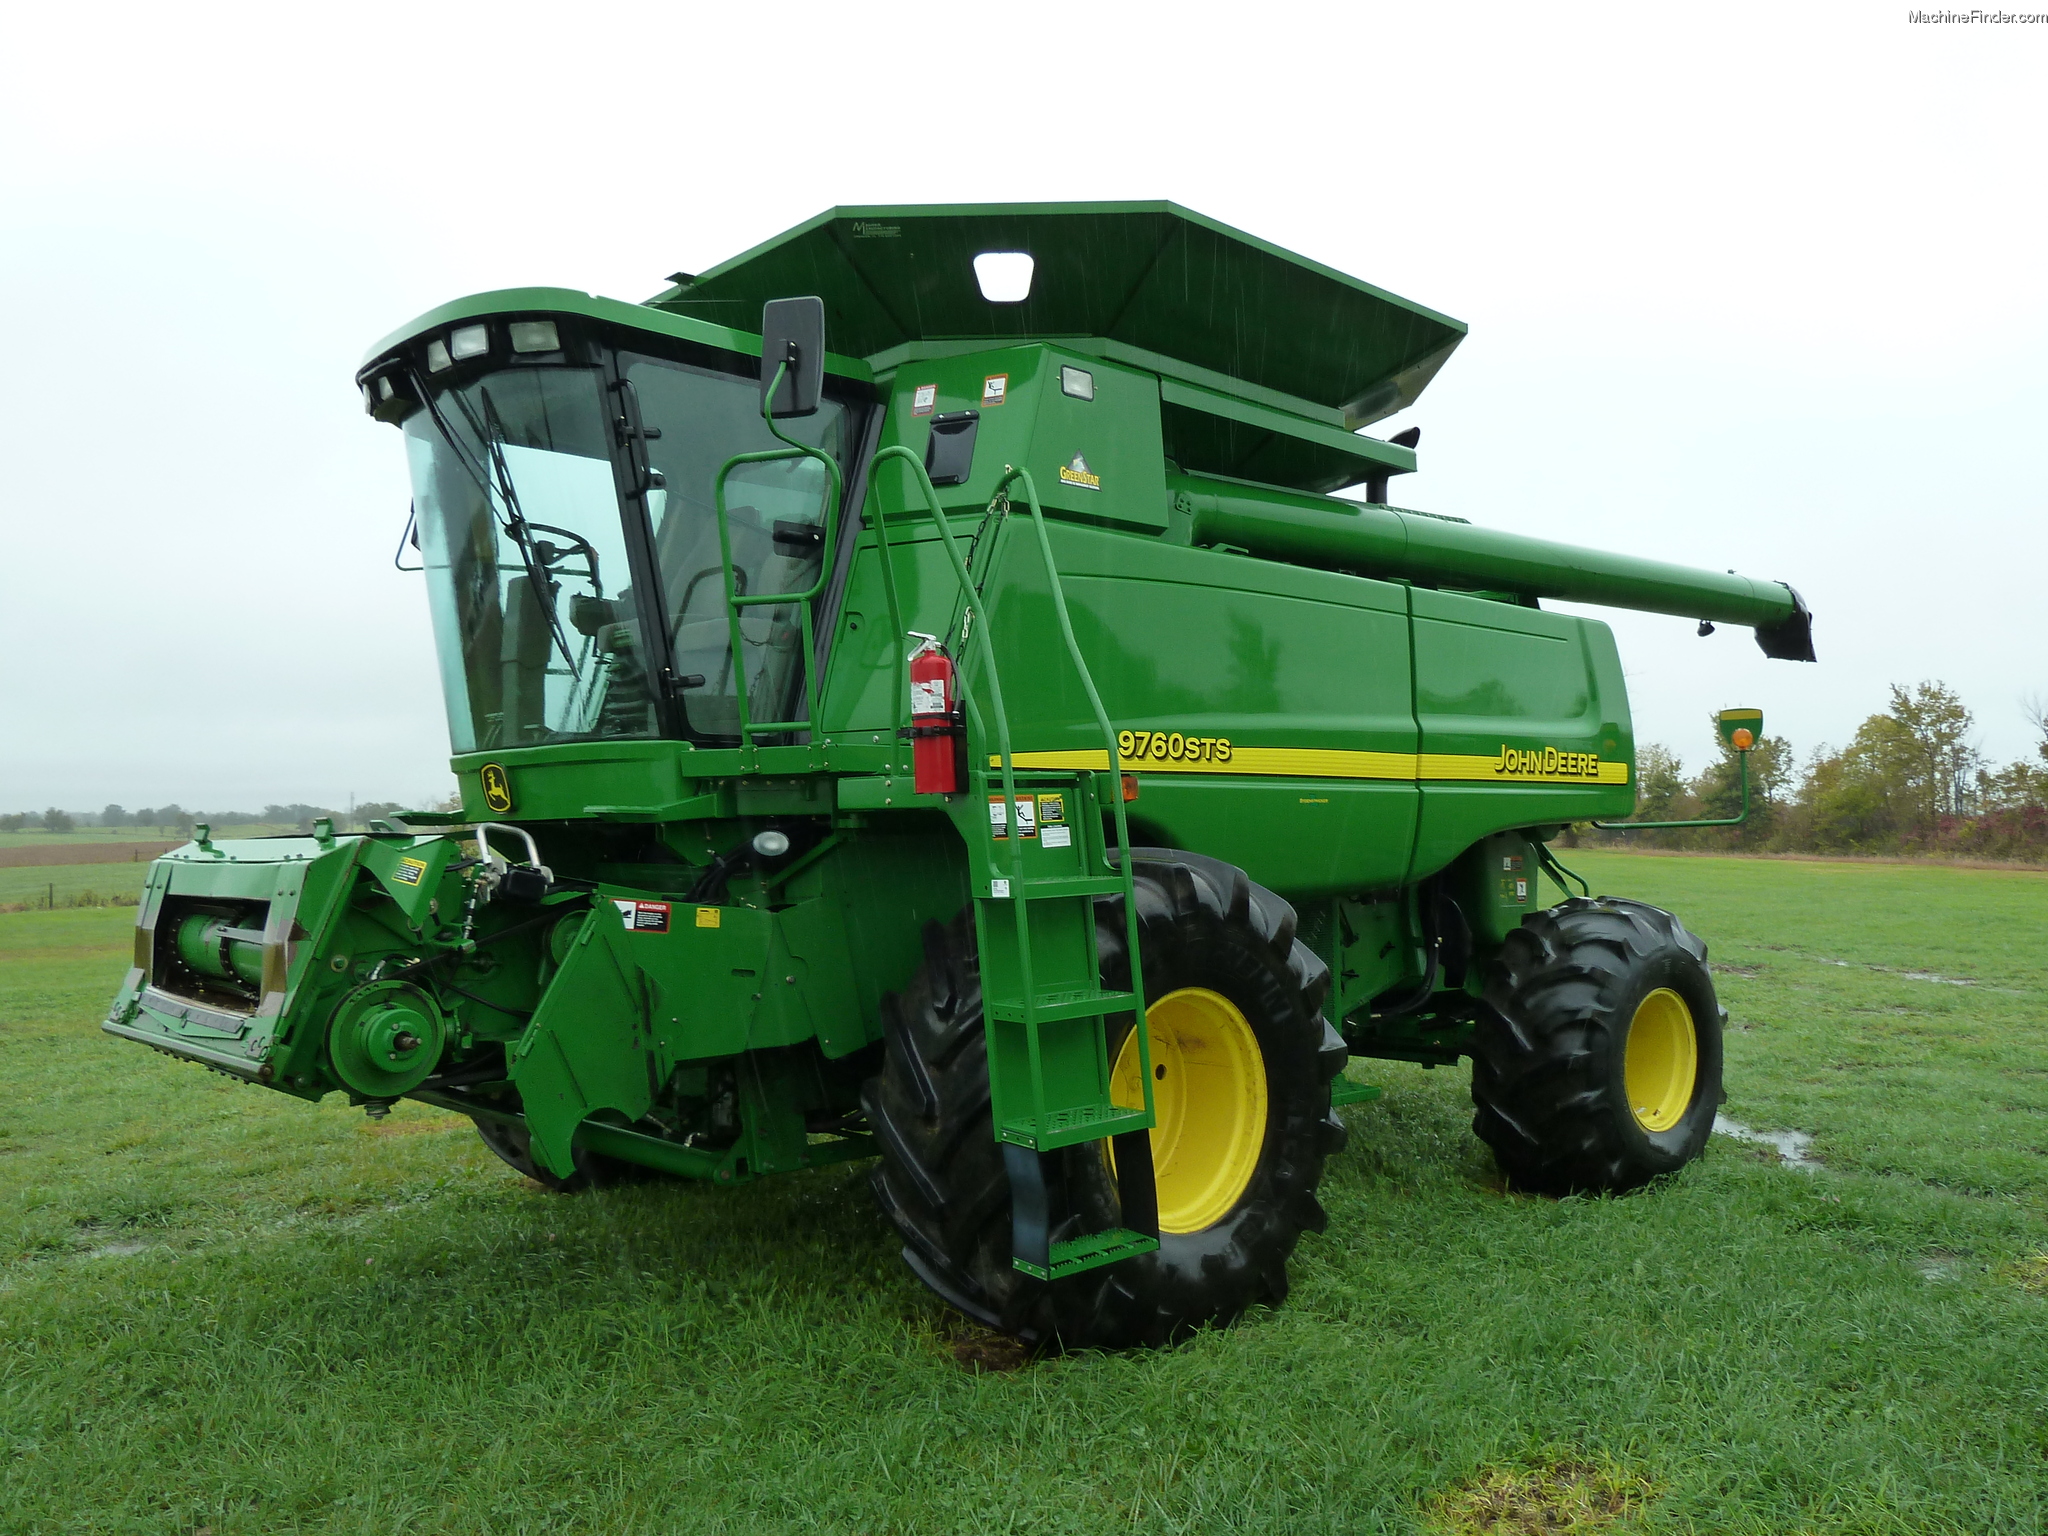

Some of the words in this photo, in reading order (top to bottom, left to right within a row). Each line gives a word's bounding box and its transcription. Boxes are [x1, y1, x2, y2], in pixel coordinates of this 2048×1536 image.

[1118, 729, 1232, 762] 9760STS
[1494, 743, 1543, 774] JOHN
[1544, 746, 1599, 777] DEERE
